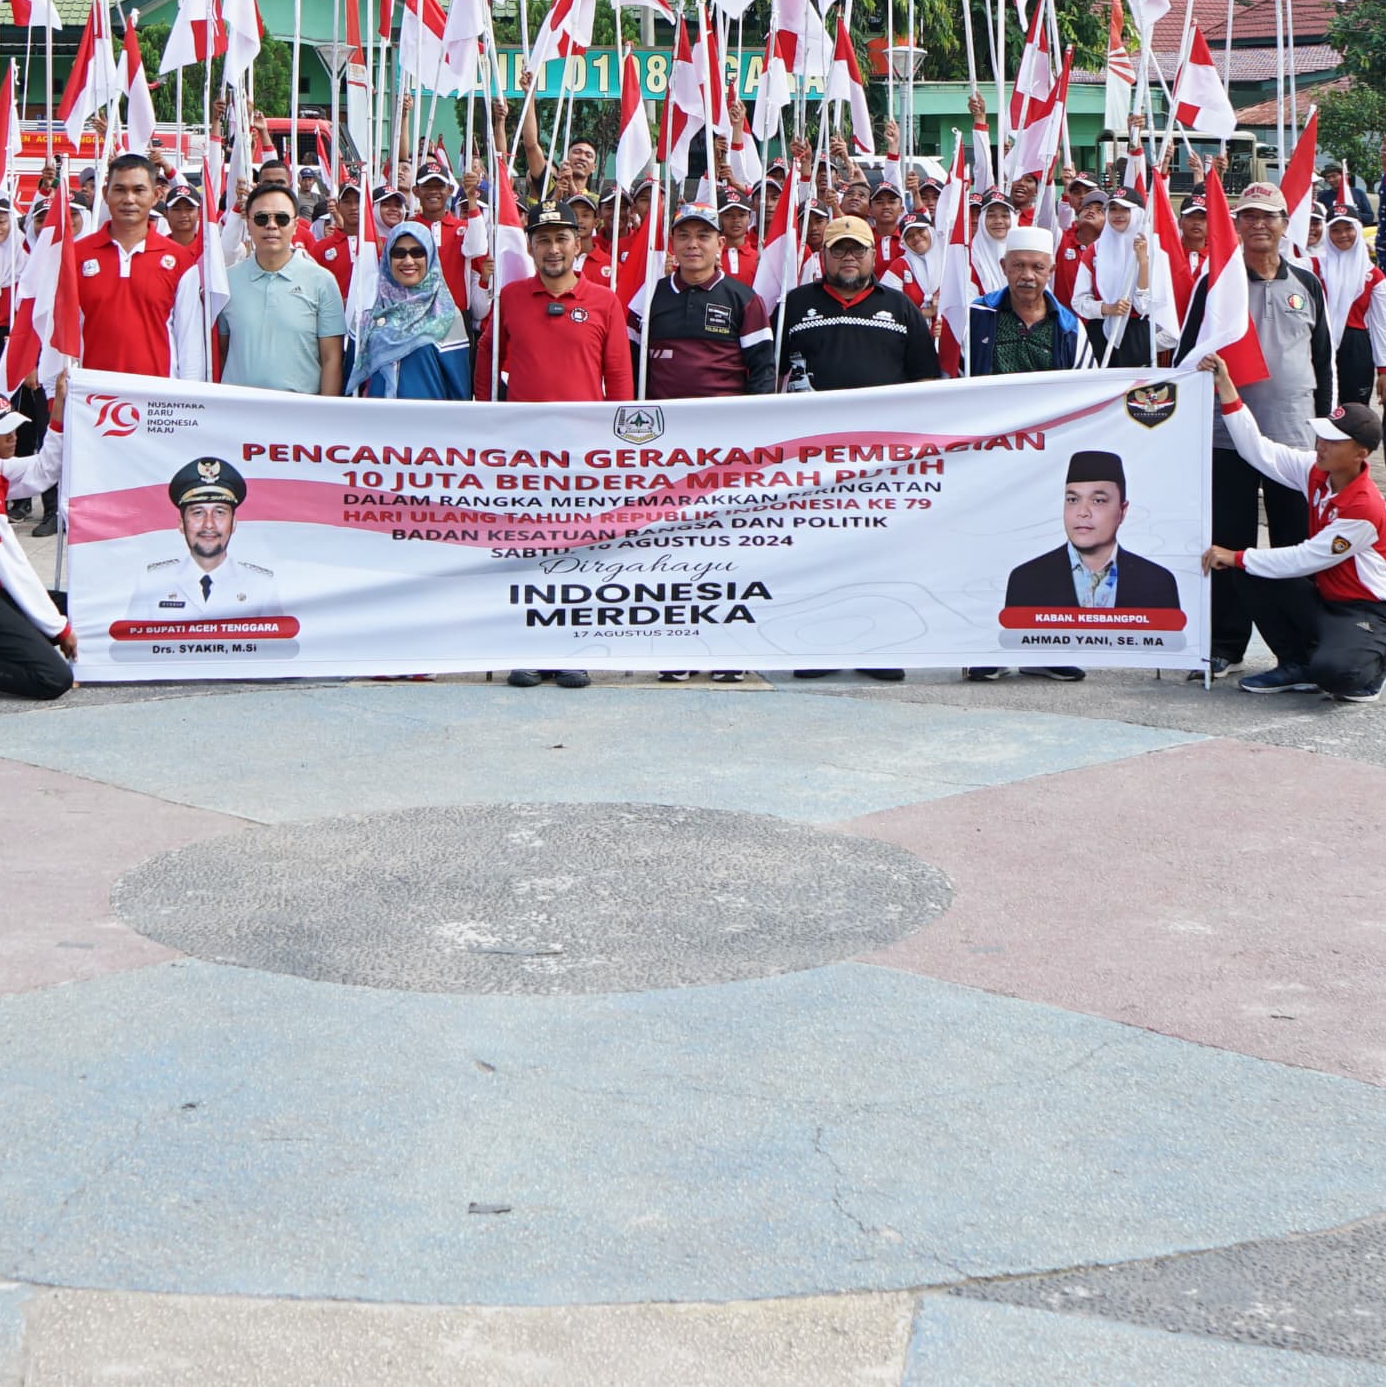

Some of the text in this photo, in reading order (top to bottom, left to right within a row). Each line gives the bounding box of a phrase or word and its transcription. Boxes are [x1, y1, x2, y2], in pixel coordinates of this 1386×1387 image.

[147, 401, 205, 410] NUSANTARA
[242, 431, 1046, 468] PENCANANGAN GERAKAN PEMBAGIAN
[342, 459, 945, 492] 10 JUTA BENDERA MERAH PUTIH
[343, 494, 431, 507] DALAM
[439, 495, 544, 508] RANGKA
[551, 493, 778, 508] MENYEMARAKKAN
[343, 498, 932, 524] HARI ULANG TAHUN REPUBLIK INDONESIA KE 79
[392, 516, 888, 542] BADAN KESATUAN BANGSA DAN POLITIK
[617, 534, 731, 549] AGUSTUS
[738, 535, 794, 547] 2024
[539, 554, 739, 582] Dirgahayu
[510, 581, 773, 605] INDONESIA
[526, 604, 757, 627] MERDEKA
[1035, 613, 1150, 624] KABAN. KESBANGPOL
[146, 626, 186, 634] BUPATI
[189, 624, 218, 633] ACEH
[220, 623, 280, 633] TENGGARA
[593, 629, 662, 638] AGUSTUS
[666, 629, 700, 637] 2024
[1021, 635, 1164, 647] AHMAD YANI, SE. MA
[152, 643, 257, 656] Drs. SYAKIR, M.Si
